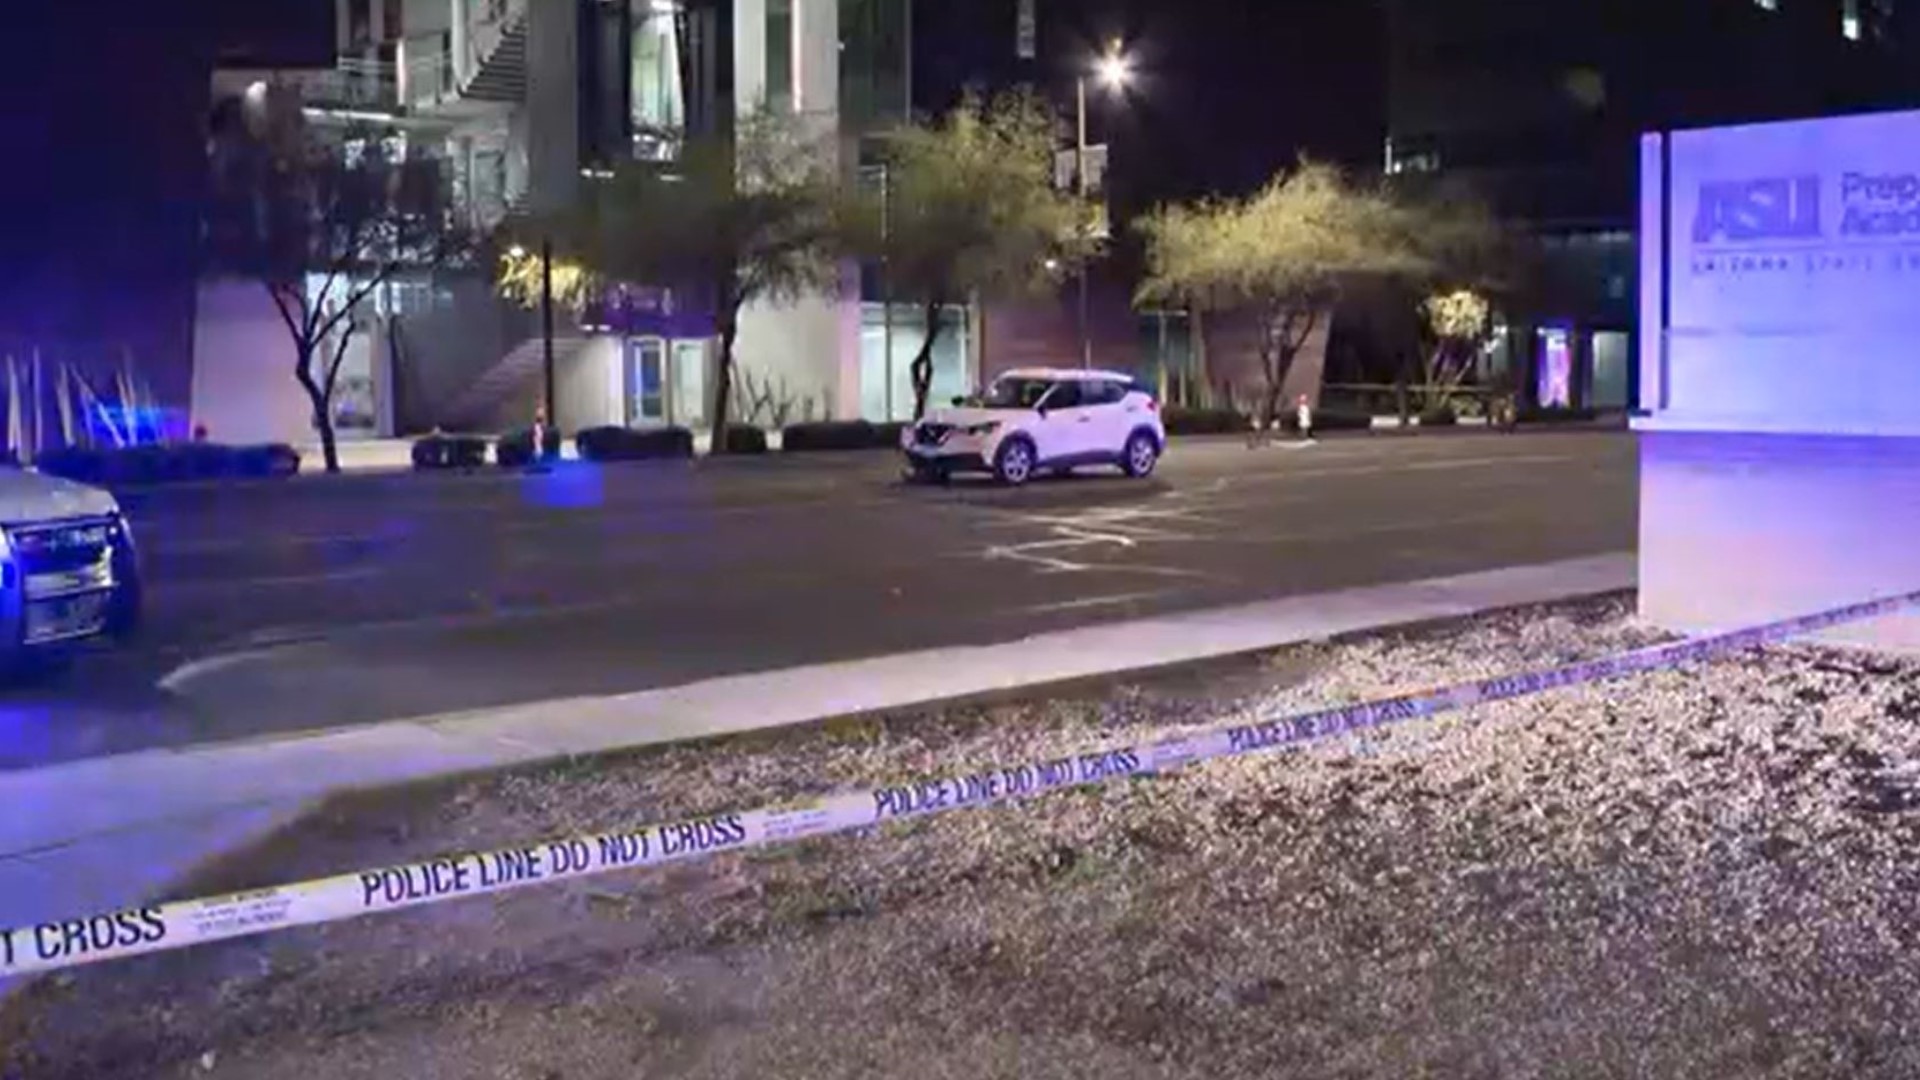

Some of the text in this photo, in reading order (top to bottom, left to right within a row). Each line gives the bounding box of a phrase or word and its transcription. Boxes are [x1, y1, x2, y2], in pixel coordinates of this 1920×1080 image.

[1692, 175, 1822, 243] ASU
[873, 779, 950, 818] POLICE
[954, 770, 996, 803] LINE
[1001, 764, 1033, 794] DO
[360, 857, 470, 906] POLICE
[475, 848, 541, 887] LINE
[549, 840, 590, 873] DO
[598, 832, 650, 865] NOT
[659, 814, 745, 855] CROSS
[34, 906, 166, 960] CROSS
